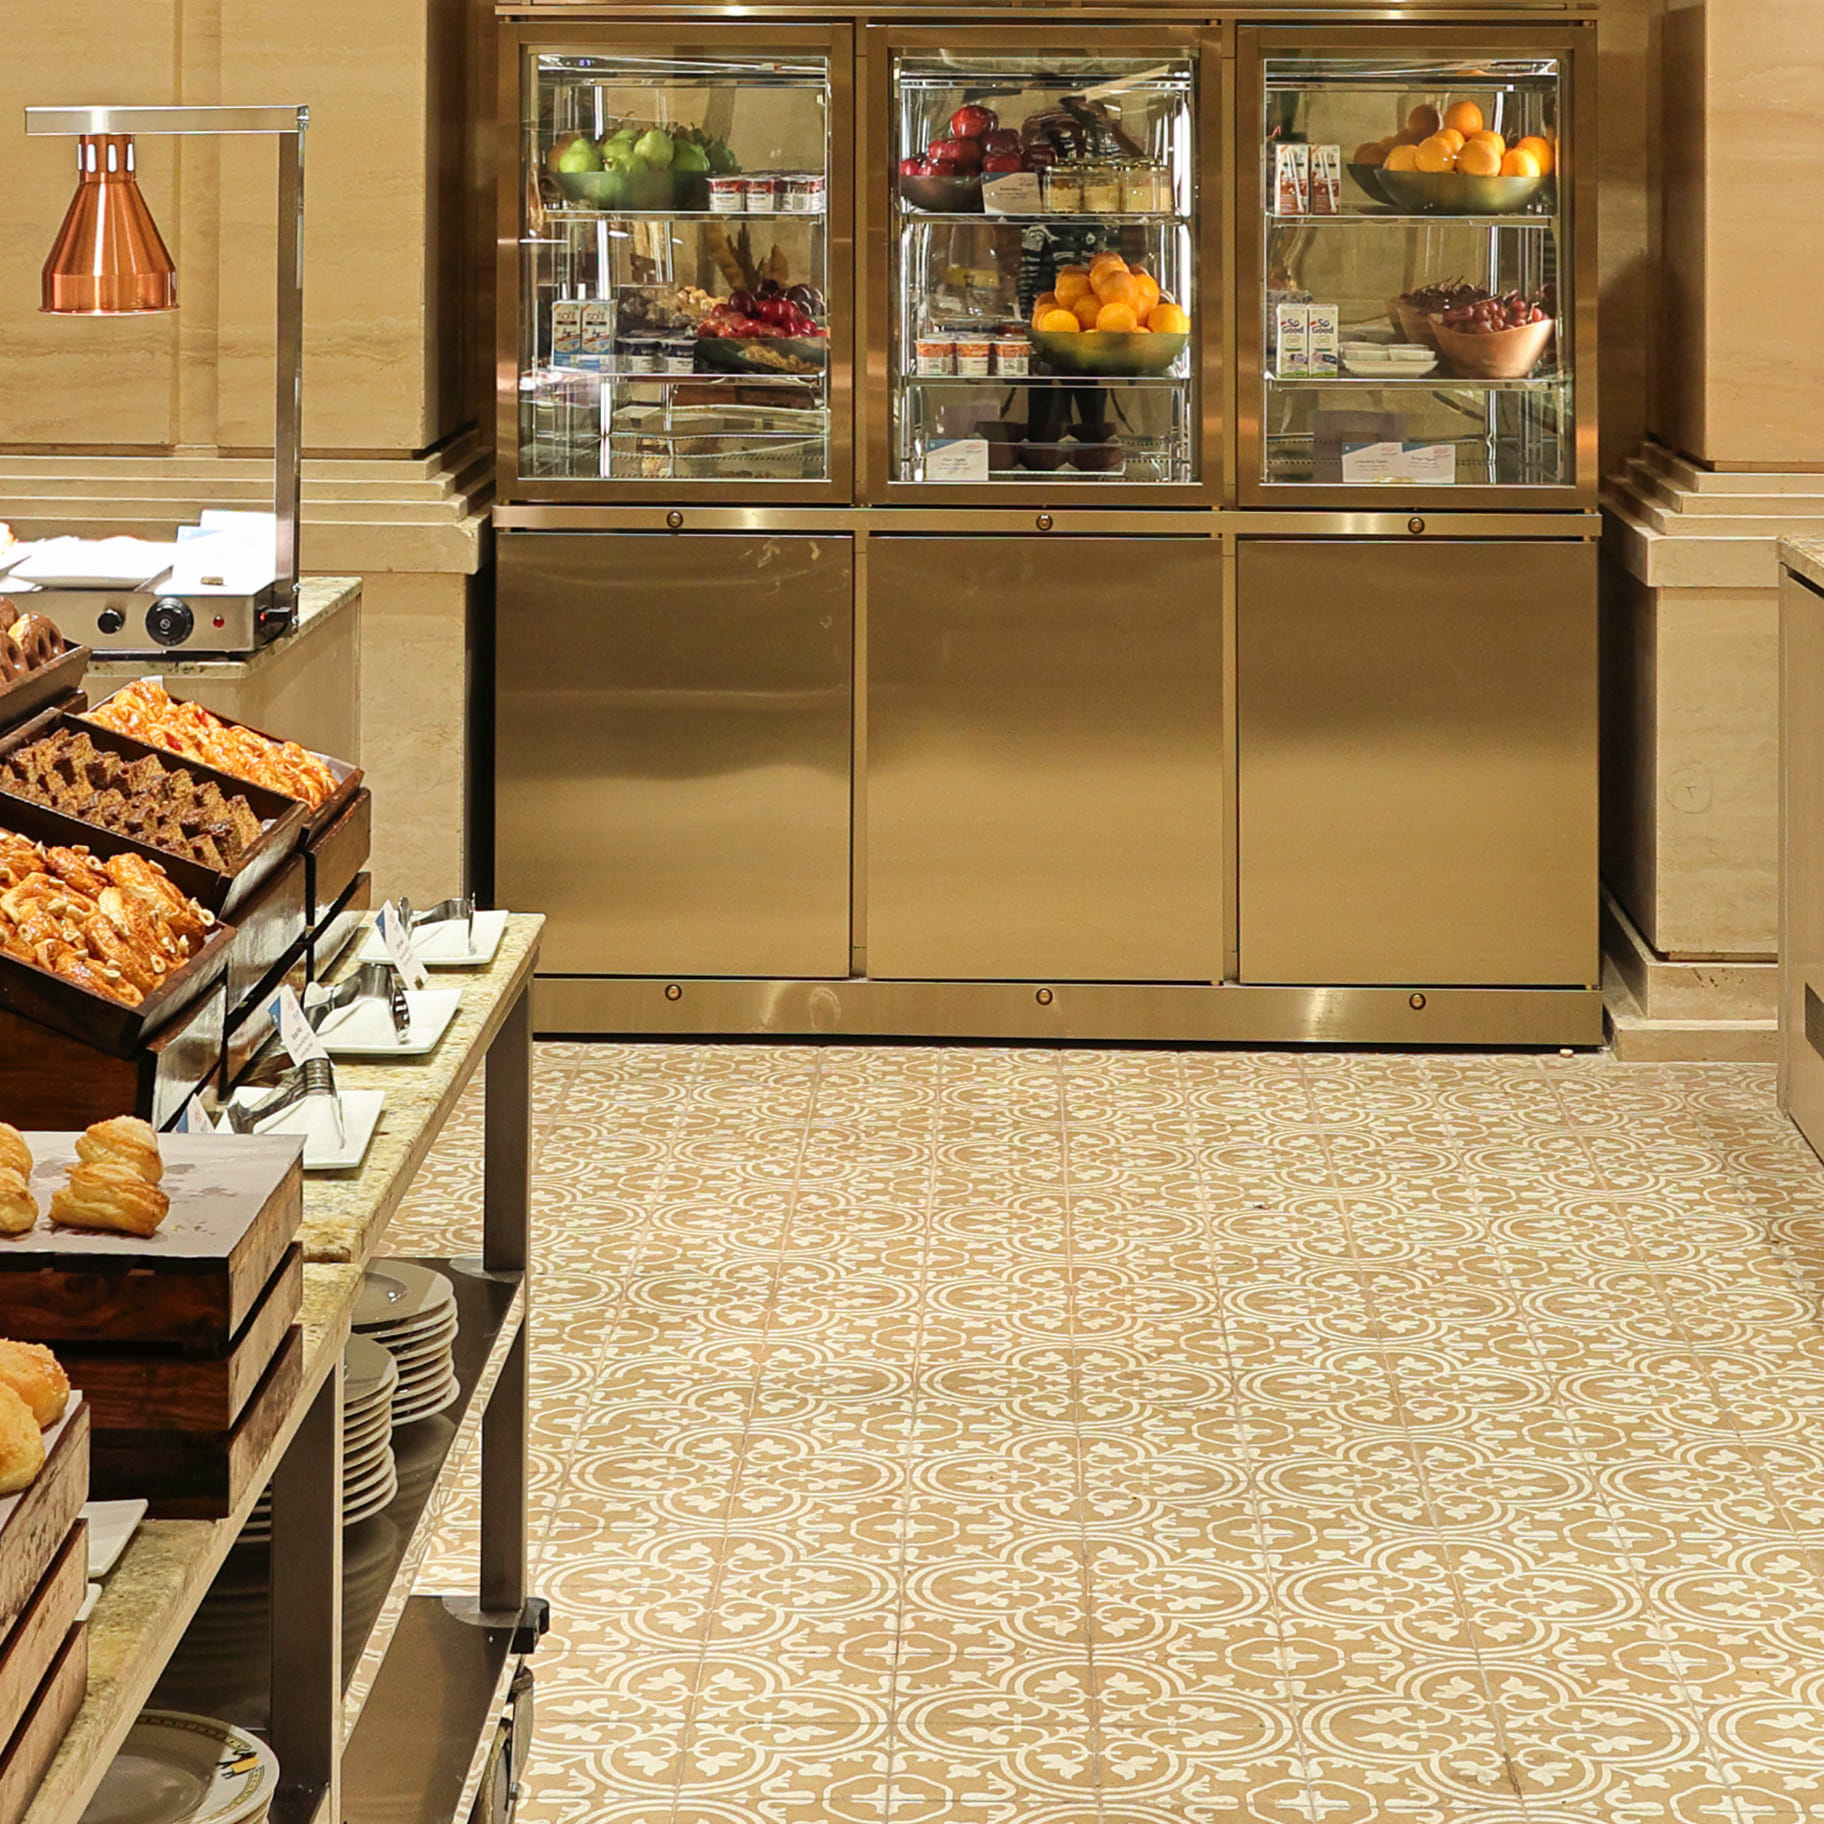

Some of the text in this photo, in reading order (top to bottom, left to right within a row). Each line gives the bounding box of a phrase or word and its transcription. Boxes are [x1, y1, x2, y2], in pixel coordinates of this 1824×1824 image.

[1287, 318, 1300, 327] So
[1317, 318, 1330, 327] So
[1281, 326, 1304, 334] Good
[1311, 326, 1334, 334] Good
